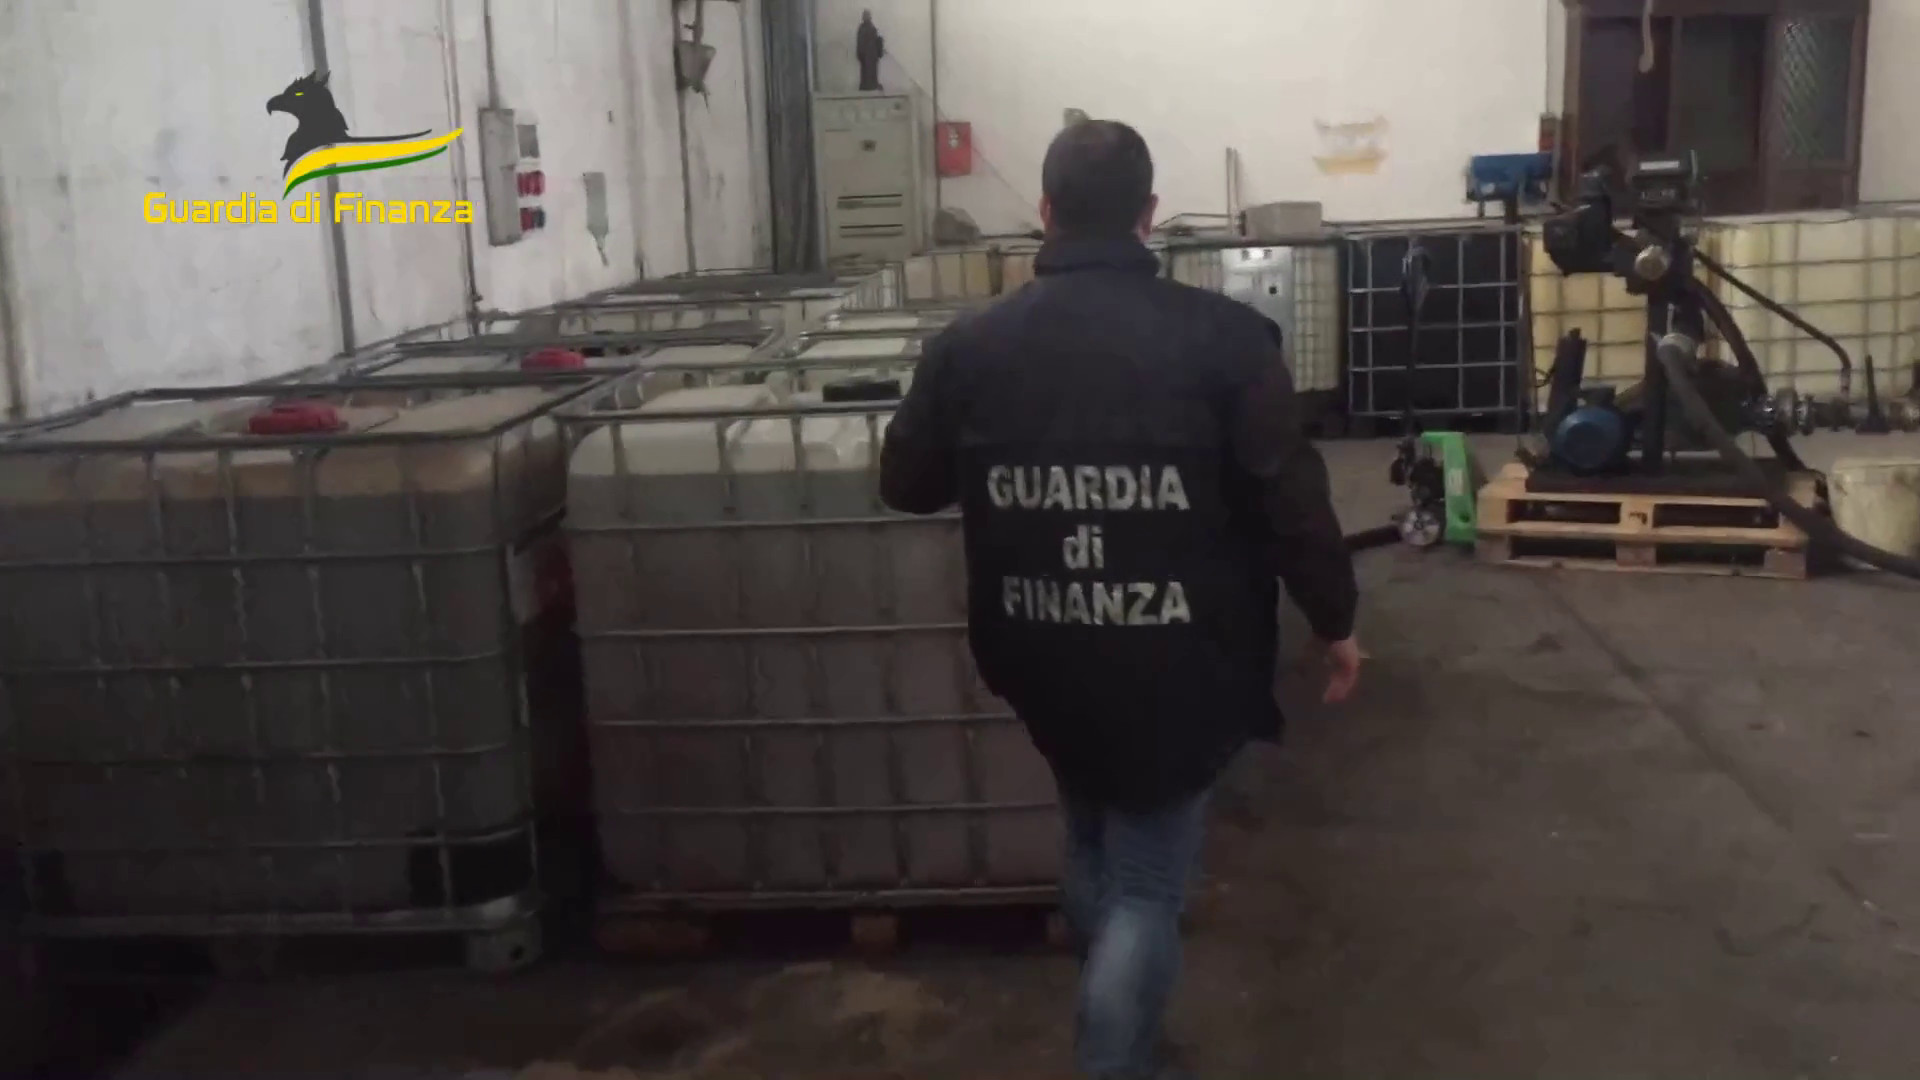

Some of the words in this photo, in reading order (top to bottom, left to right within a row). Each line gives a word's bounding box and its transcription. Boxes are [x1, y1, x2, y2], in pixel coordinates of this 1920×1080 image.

[987, 464, 1190, 511] GUARDIA
[1062, 523, 1105, 570] di
[1003, 575, 1191, 626] FINANZA
